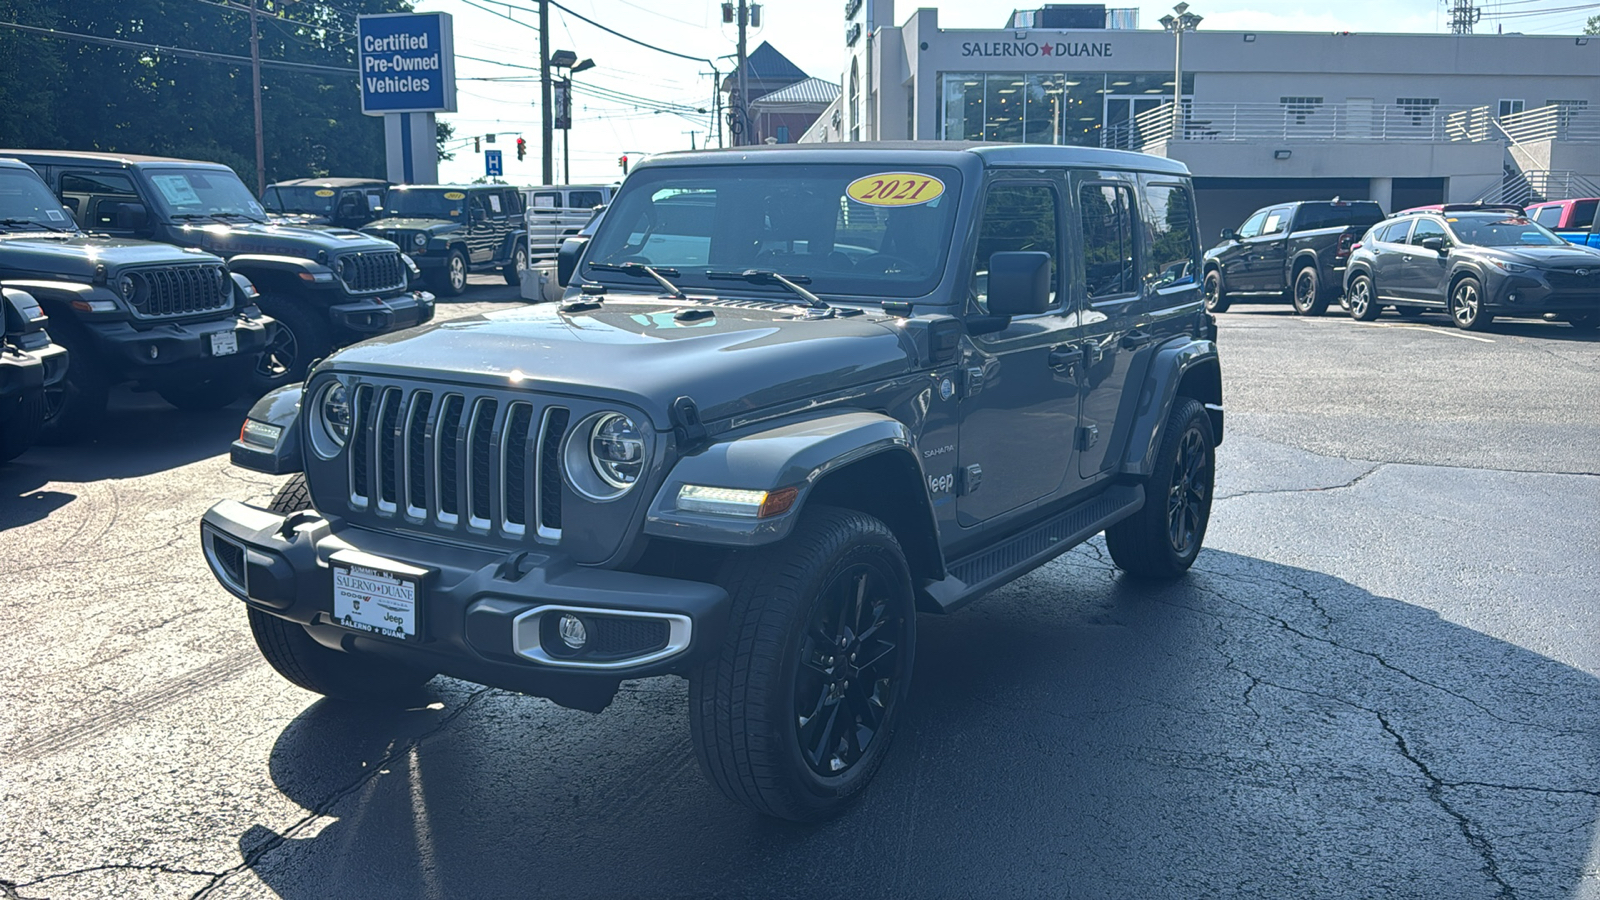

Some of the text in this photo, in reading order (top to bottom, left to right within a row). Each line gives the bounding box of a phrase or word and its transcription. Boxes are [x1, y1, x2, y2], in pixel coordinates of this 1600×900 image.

[364, 33, 428, 52] Certified
[961, 42, 1113, 57] SALERNO DUANE
[365, 53, 439, 73] Pre-Owned
[366, 76, 430, 93] Vehicles
[488, 155, 499, 169] H
[860, 180, 931, 200] 2021
[924, 444, 955, 459] SAHARA
[927, 473, 954, 493] Jeep
[336, 575, 414, 600] SALERNO DUANE
[383, 612, 404, 625] Jeep
[340, 619, 406, 640] SALERNO DUANE
